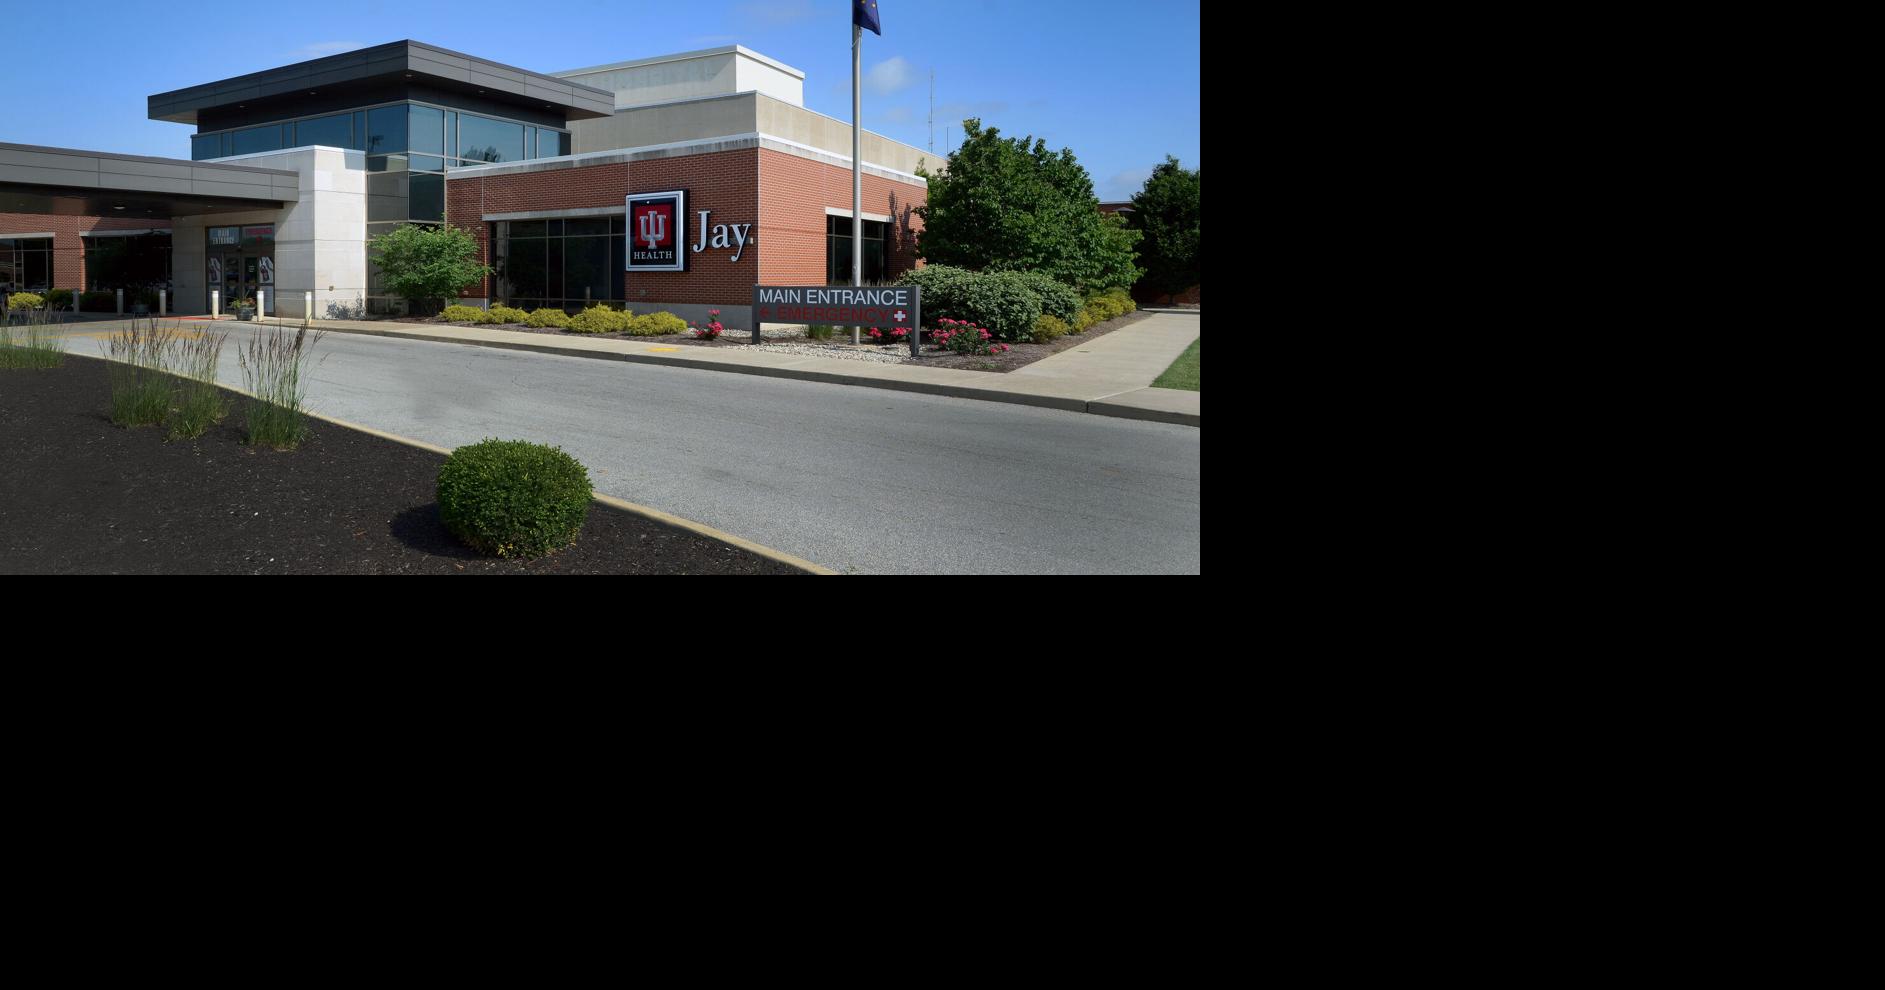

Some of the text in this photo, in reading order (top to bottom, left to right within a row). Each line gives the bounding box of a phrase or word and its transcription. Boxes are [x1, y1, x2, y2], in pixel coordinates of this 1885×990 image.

[633, 251, 673, 260] HEALTH
[759, 289, 908, 306] MAIN ENTRANCE
[776, 306, 890, 323] EMERGENCY
